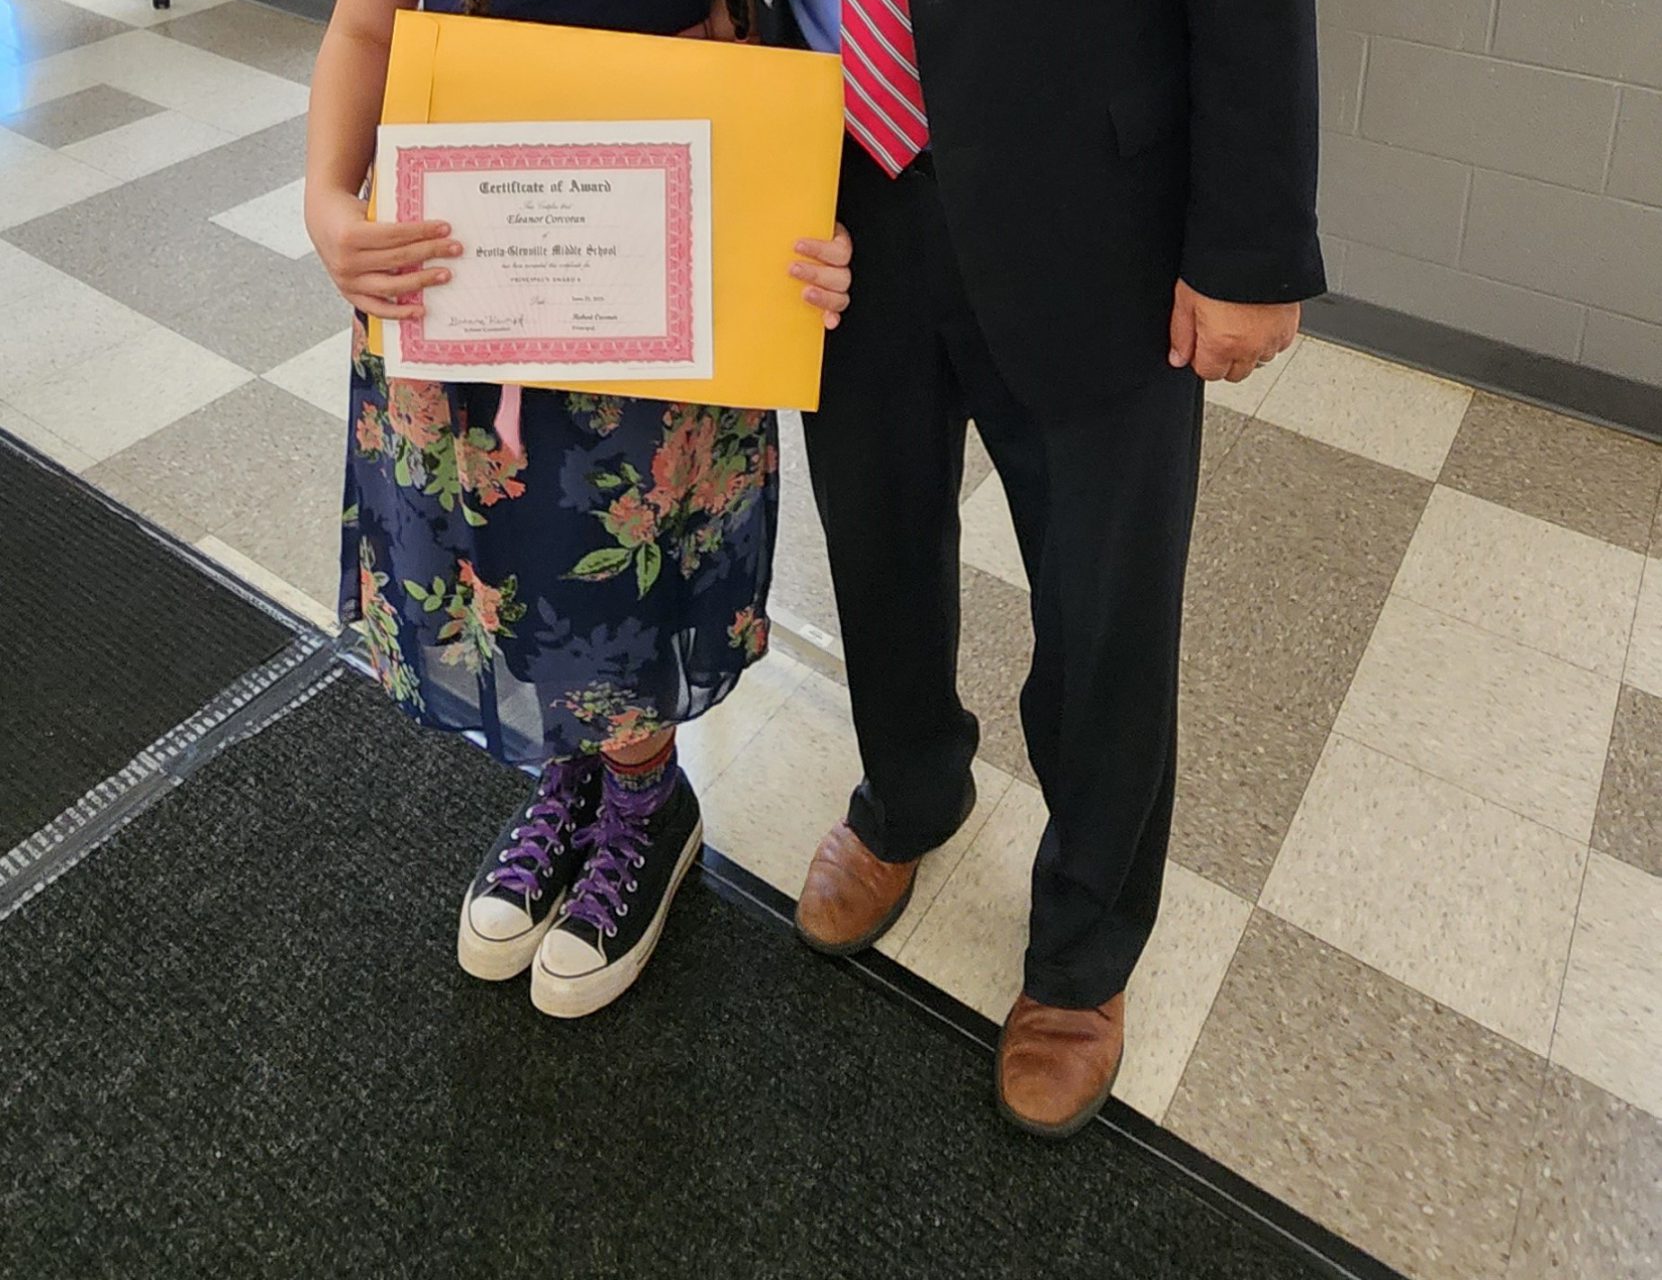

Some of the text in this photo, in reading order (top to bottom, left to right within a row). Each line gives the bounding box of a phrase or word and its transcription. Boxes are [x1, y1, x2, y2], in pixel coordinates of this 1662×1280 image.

[479, 179, 611, 194] Certificate of Award
[507, 213, 586, 224] Eleanor Corcoran
[476, 243, 617, 258] Scotia-Glenville Middle School
